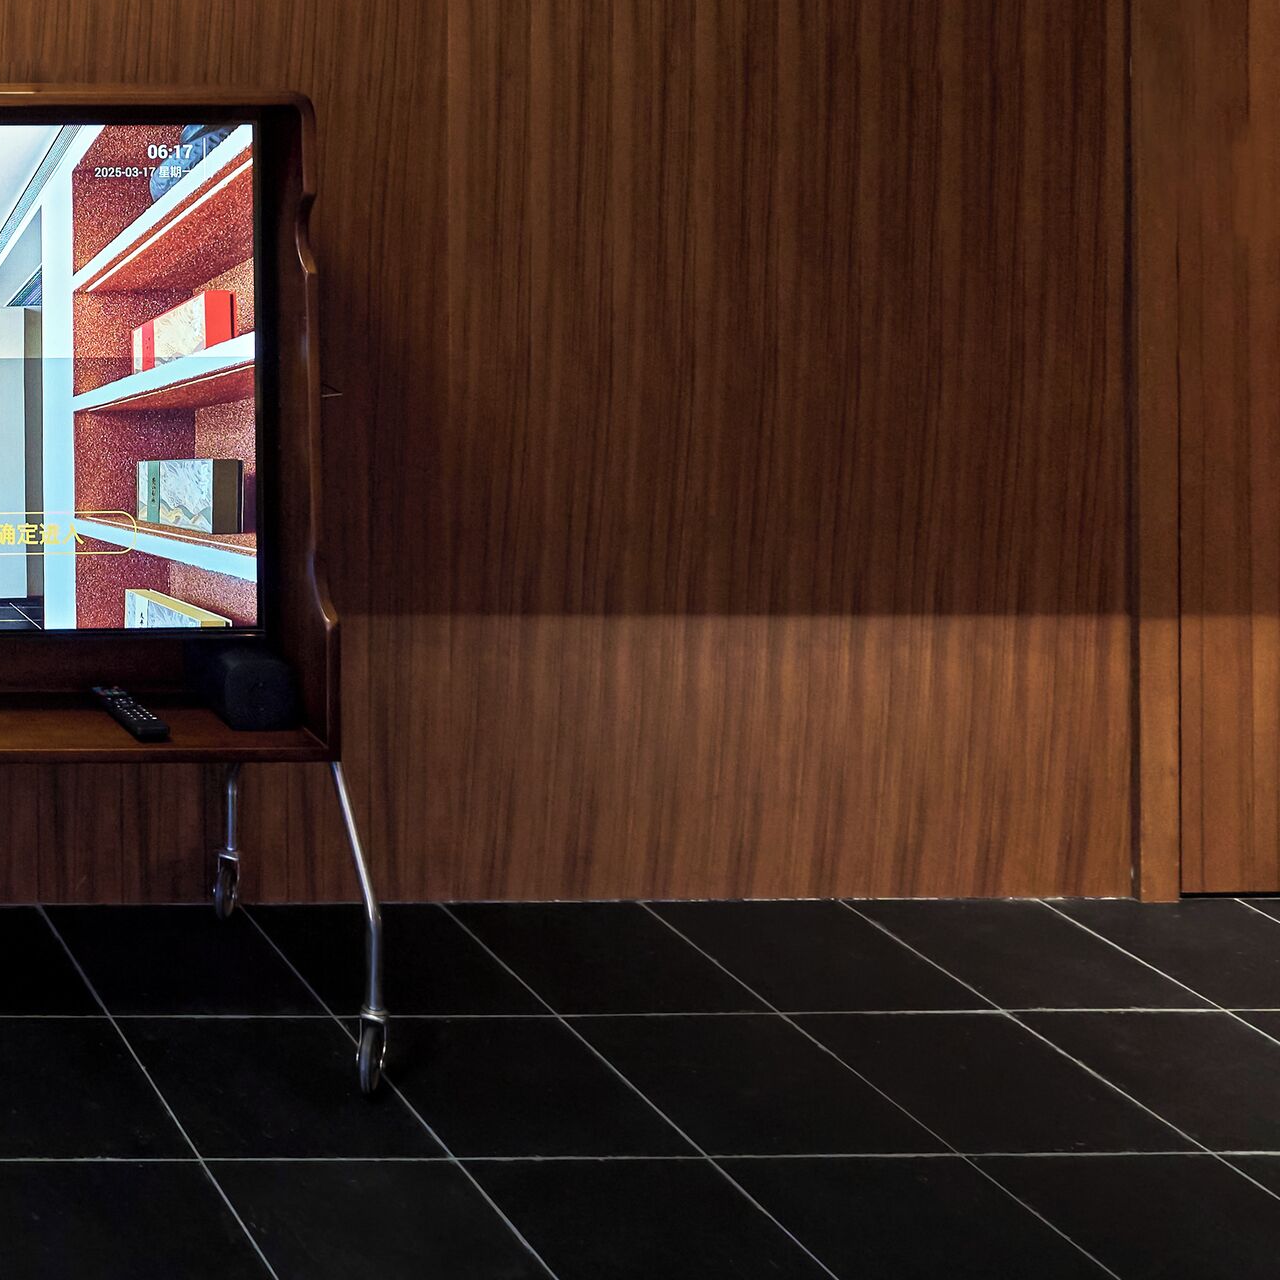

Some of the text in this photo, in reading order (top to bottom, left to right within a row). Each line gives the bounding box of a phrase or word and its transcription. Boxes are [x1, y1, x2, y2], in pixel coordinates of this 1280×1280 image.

[147, 144, 193, 159] 06:17
[94, 166, 193, 178] 2025-03-17 星期一
